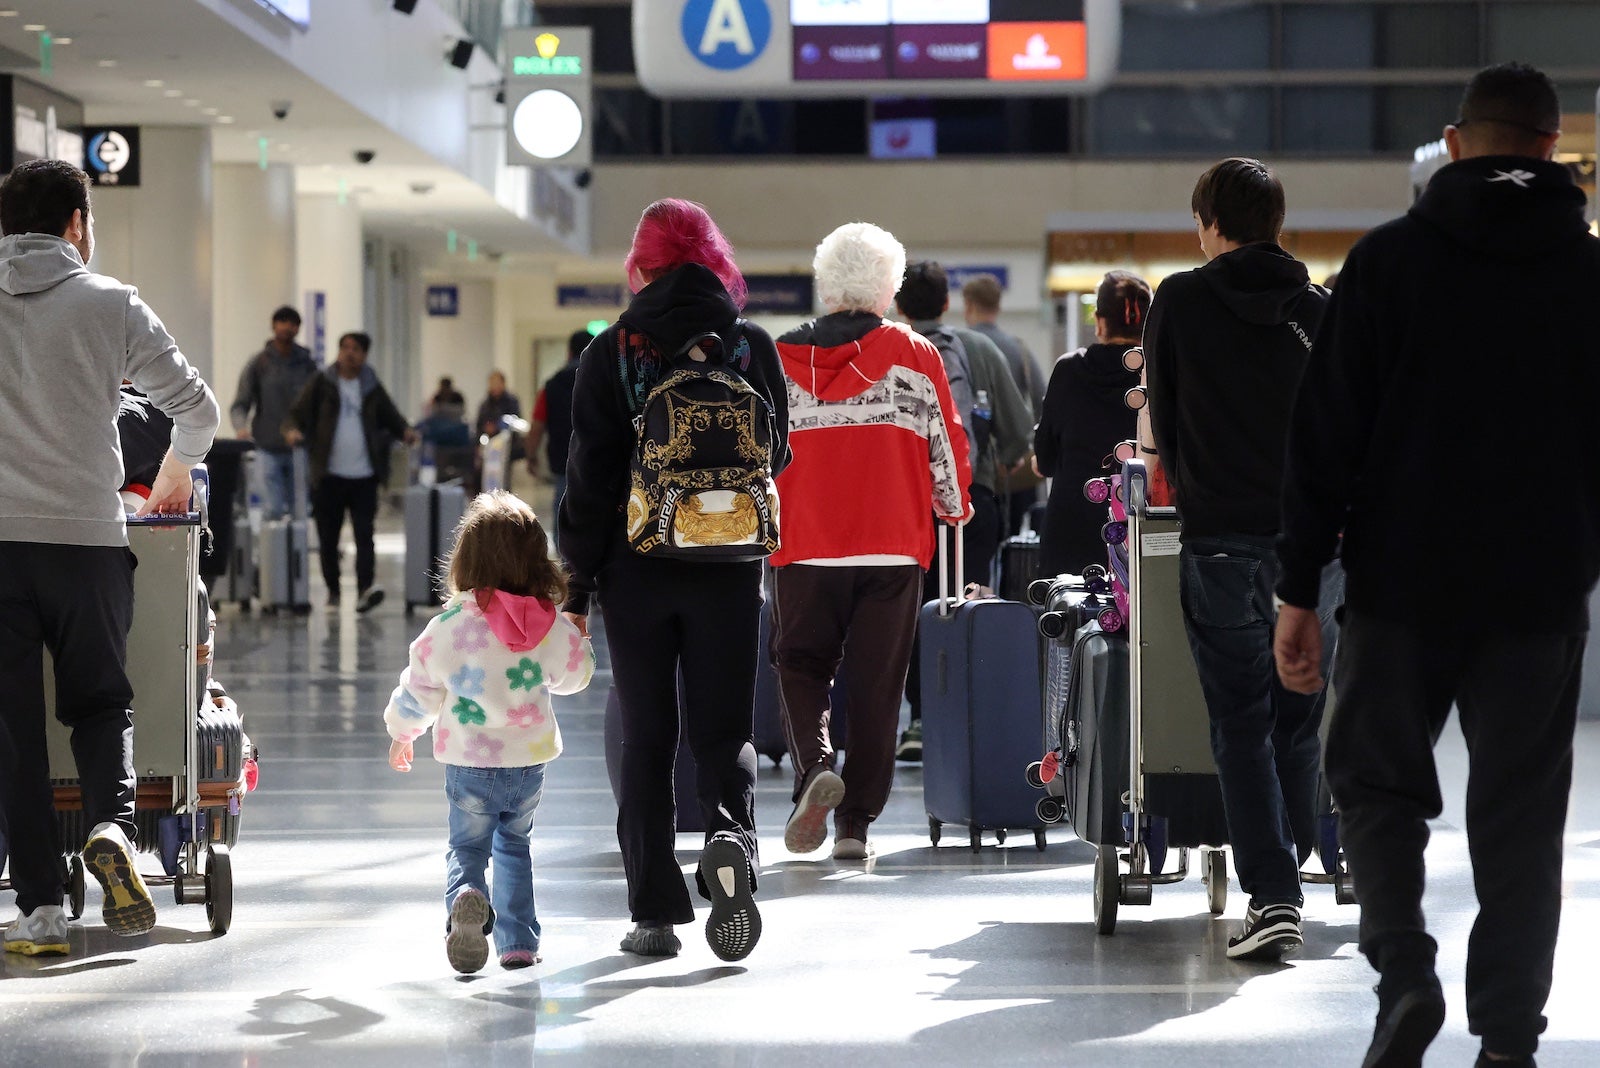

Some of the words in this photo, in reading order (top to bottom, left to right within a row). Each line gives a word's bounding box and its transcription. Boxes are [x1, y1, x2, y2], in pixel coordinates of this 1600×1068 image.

[699, 0, 755, 55] A
[513, 56, 582, 75] ROLEX
[1287, 321, 1313, 352] ARM
